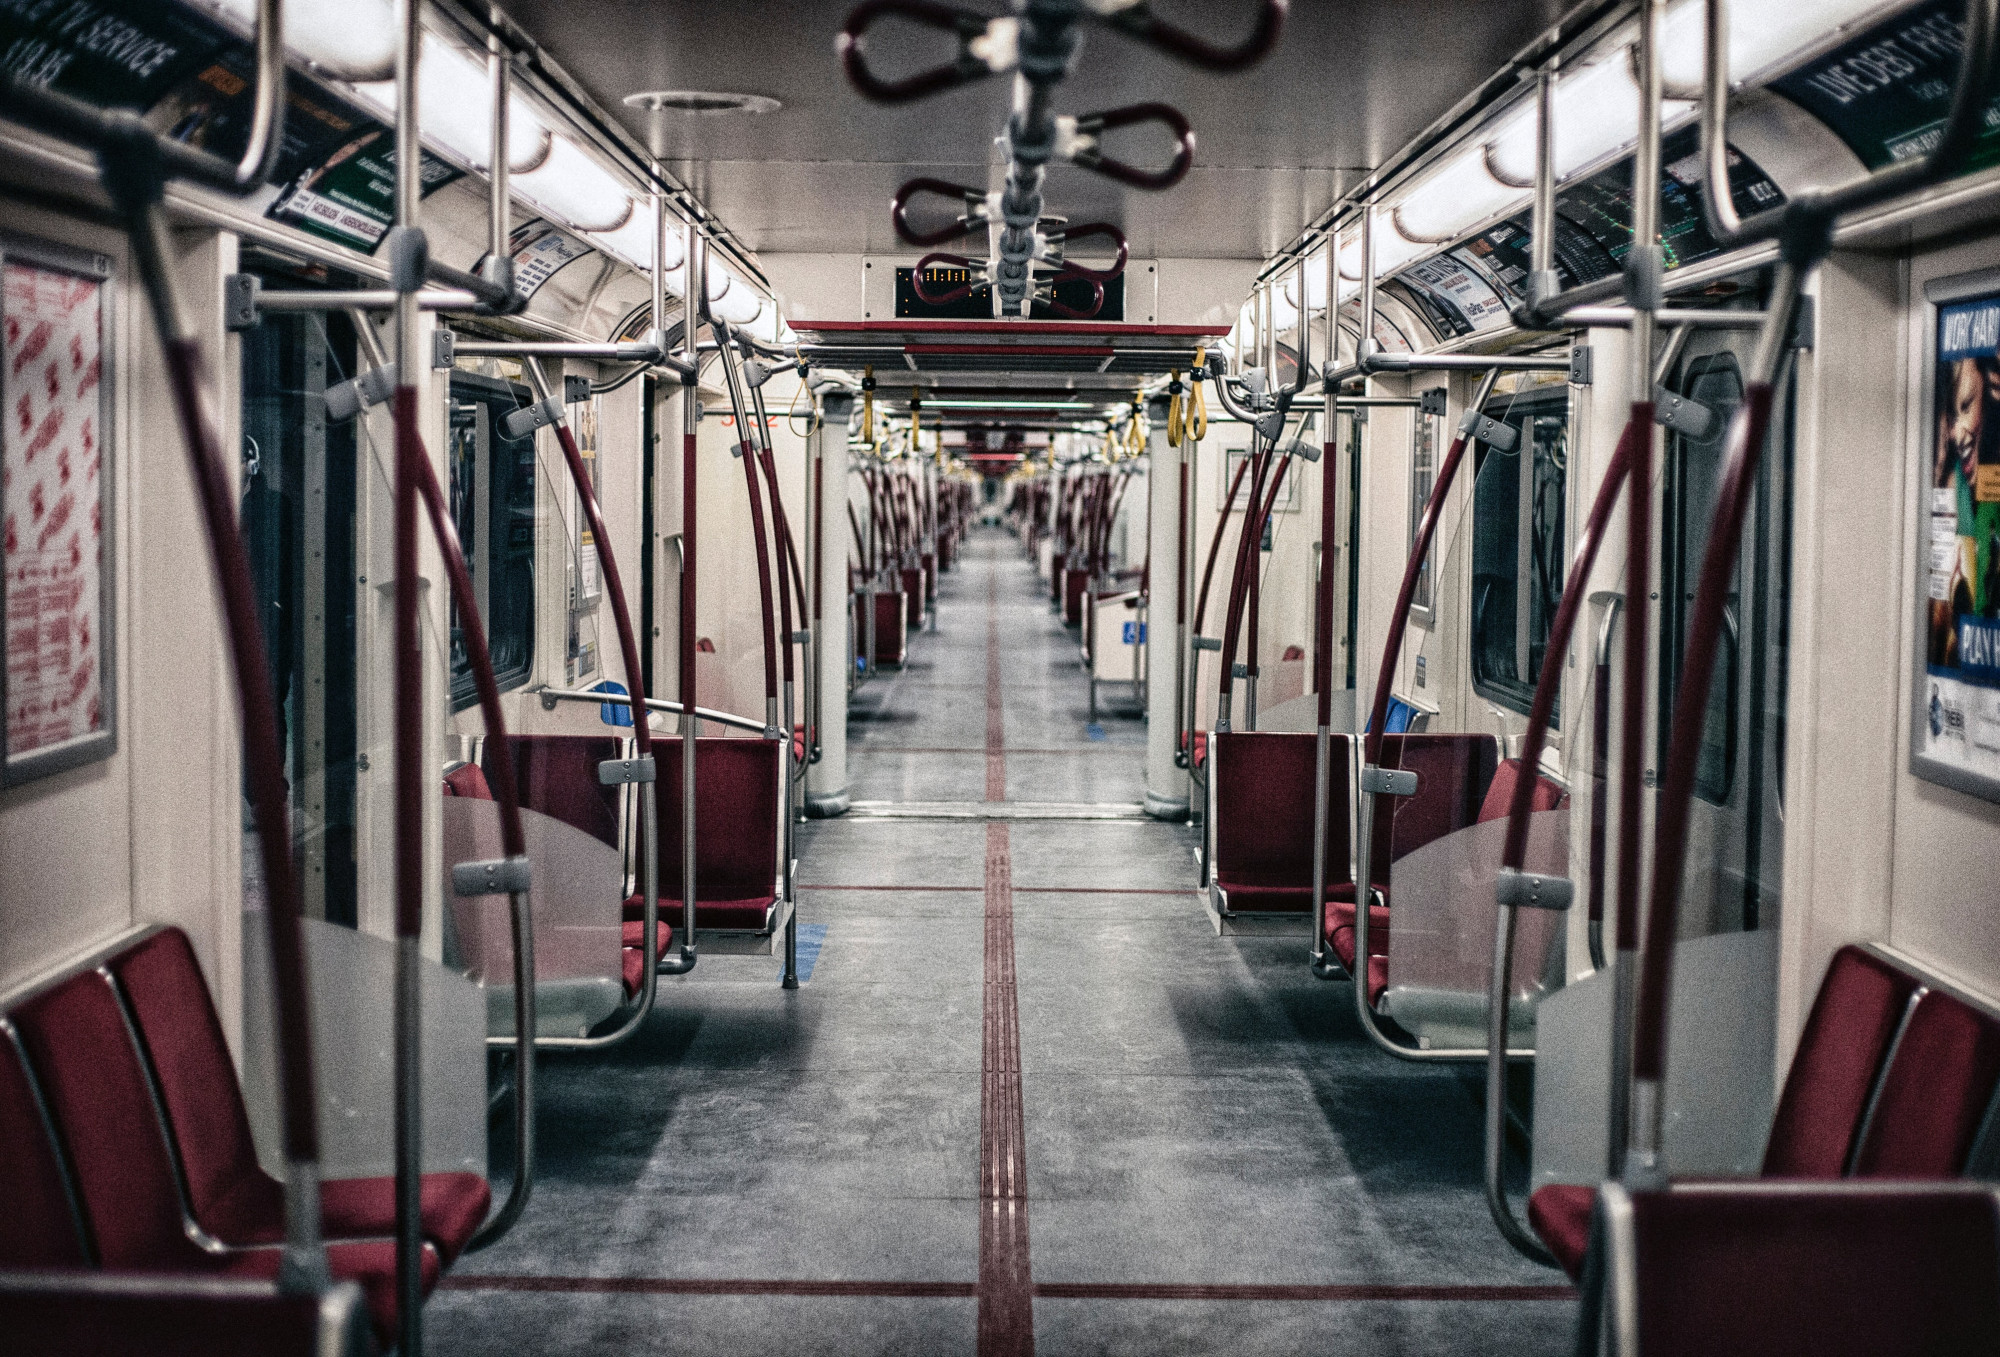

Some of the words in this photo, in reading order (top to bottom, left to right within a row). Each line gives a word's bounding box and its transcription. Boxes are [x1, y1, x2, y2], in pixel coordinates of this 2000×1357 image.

[75, 15, 178, 78] SERVICE
[1805, 65, 1878, 104] LIVE
[1846, 39, 1926, 86] DEBT
[1943, 311, 1974, 352] WORK
[1962, 623, 1992, 666] PLAY
